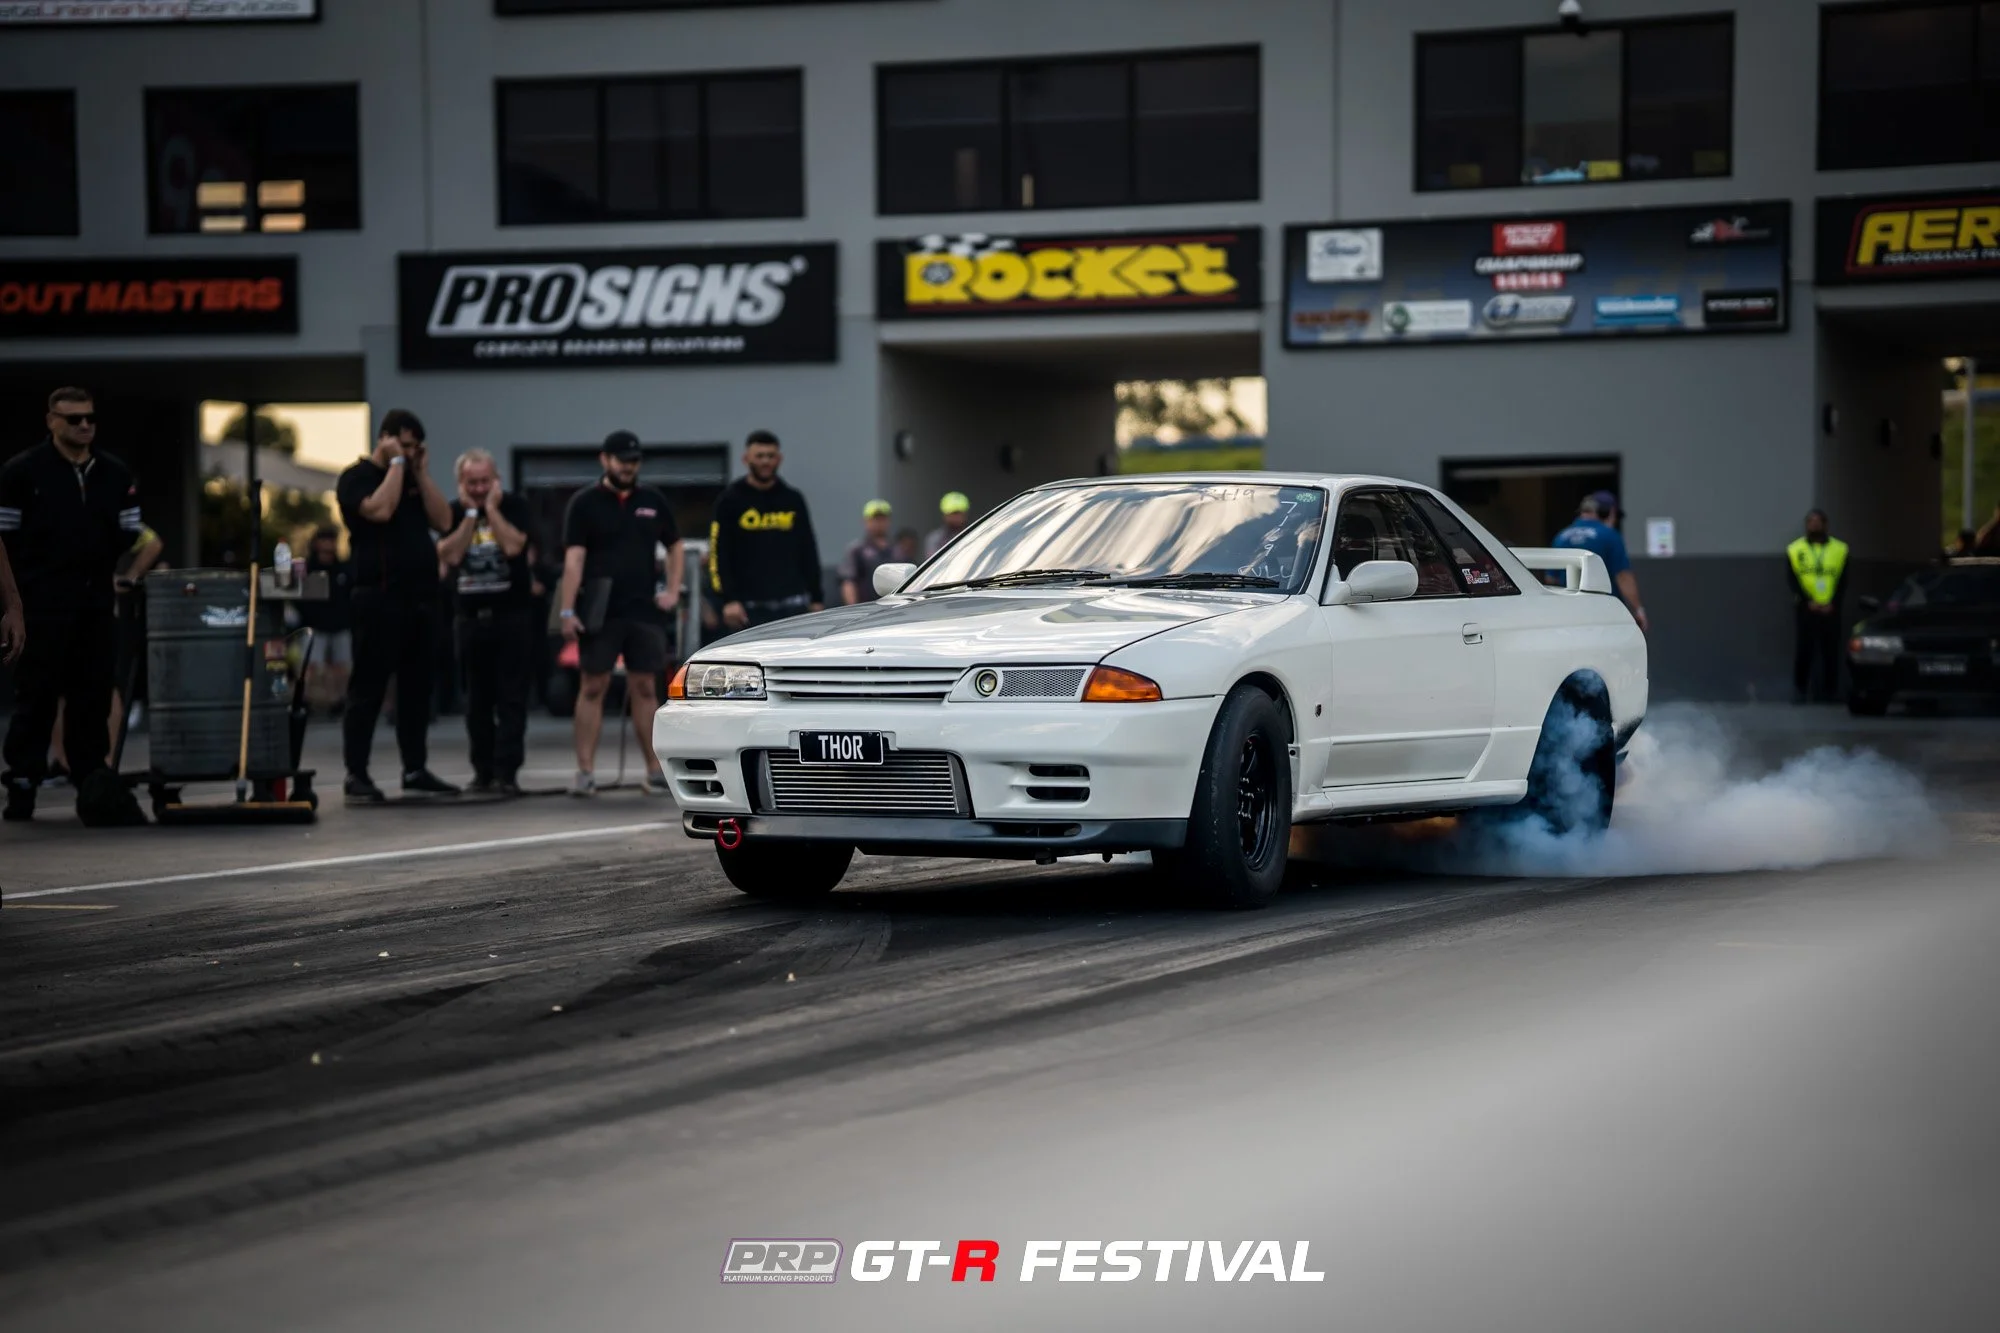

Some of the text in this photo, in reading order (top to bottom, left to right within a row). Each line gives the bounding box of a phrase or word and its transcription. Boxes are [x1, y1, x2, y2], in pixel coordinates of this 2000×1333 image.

[86, 277, 282, 313] MASTERS
[434, 261, 795, 330] PROSIGNS
[818, 735, 864, 760] THOR
